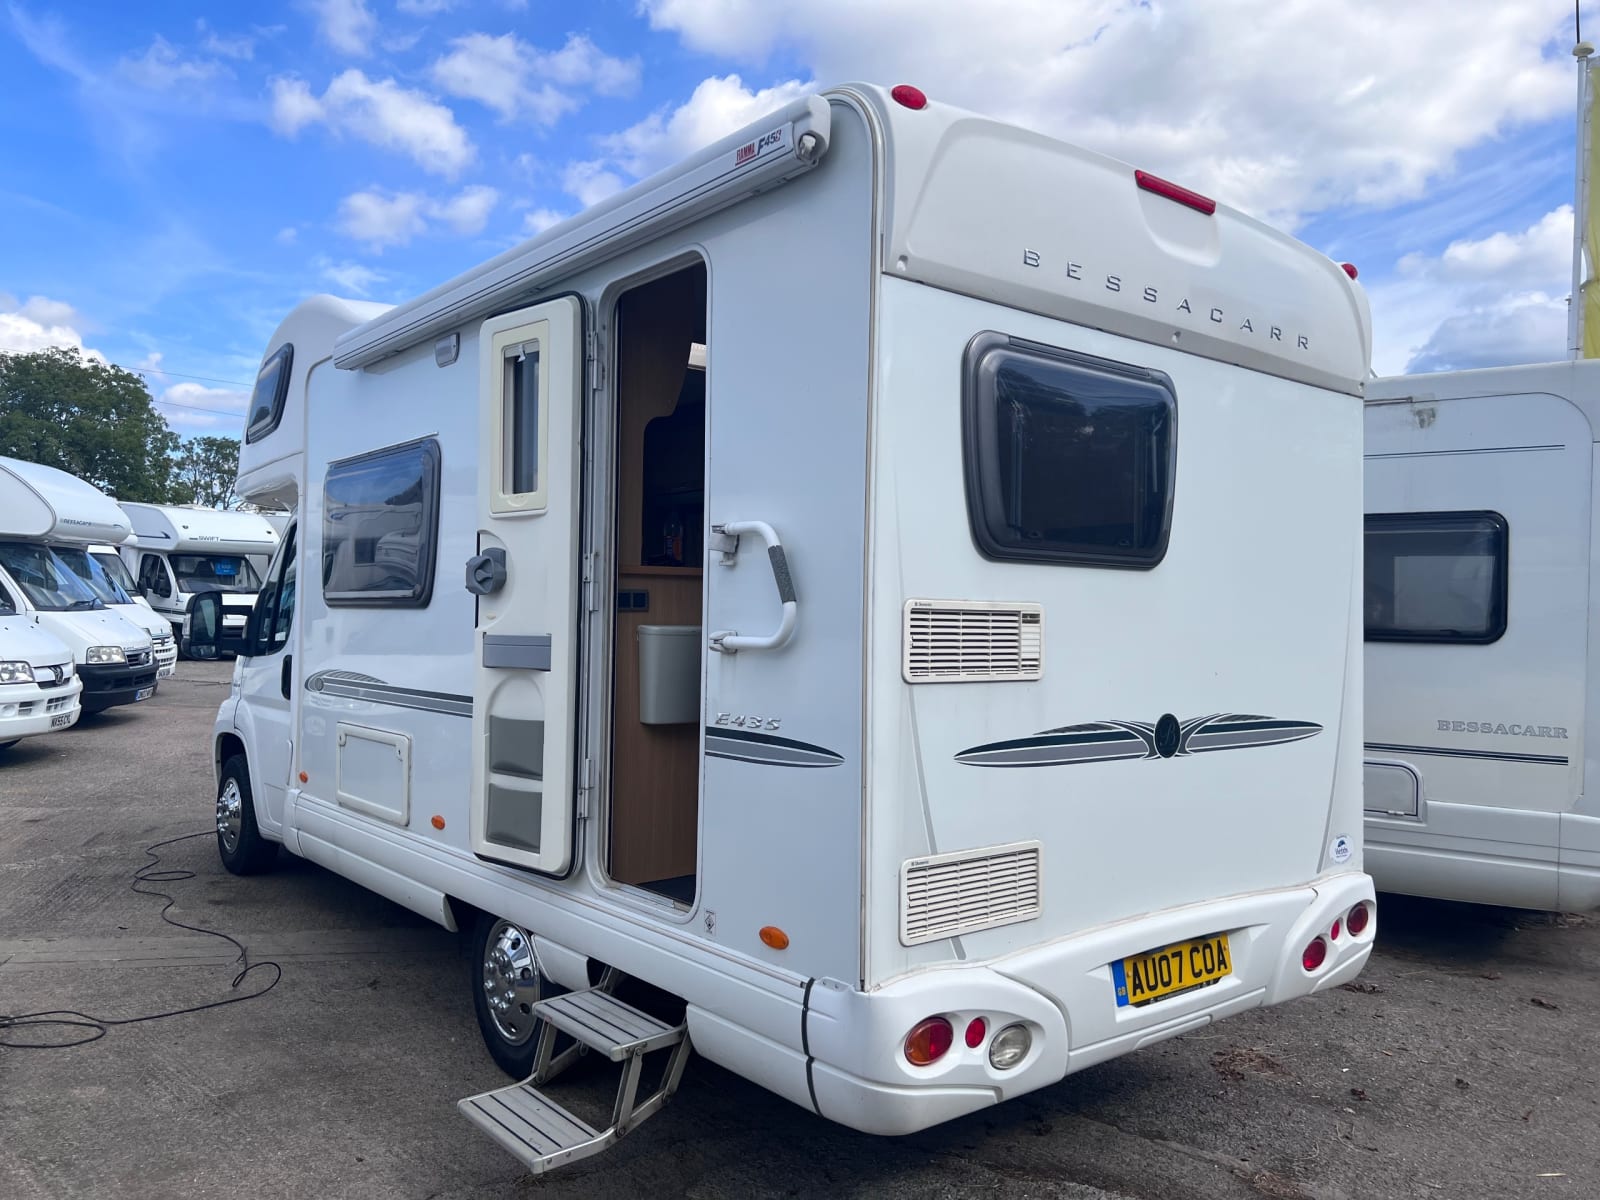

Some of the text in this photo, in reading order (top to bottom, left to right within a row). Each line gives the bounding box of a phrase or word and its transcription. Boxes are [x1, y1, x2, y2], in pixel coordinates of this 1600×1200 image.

[1023, 248, 1309, 350] BESSACARR
[715, 712, 781, 730] E435
[1437, 719, 1569, 739] BESSACARR
[1132, 939, 1228, 997] AU07 COA
